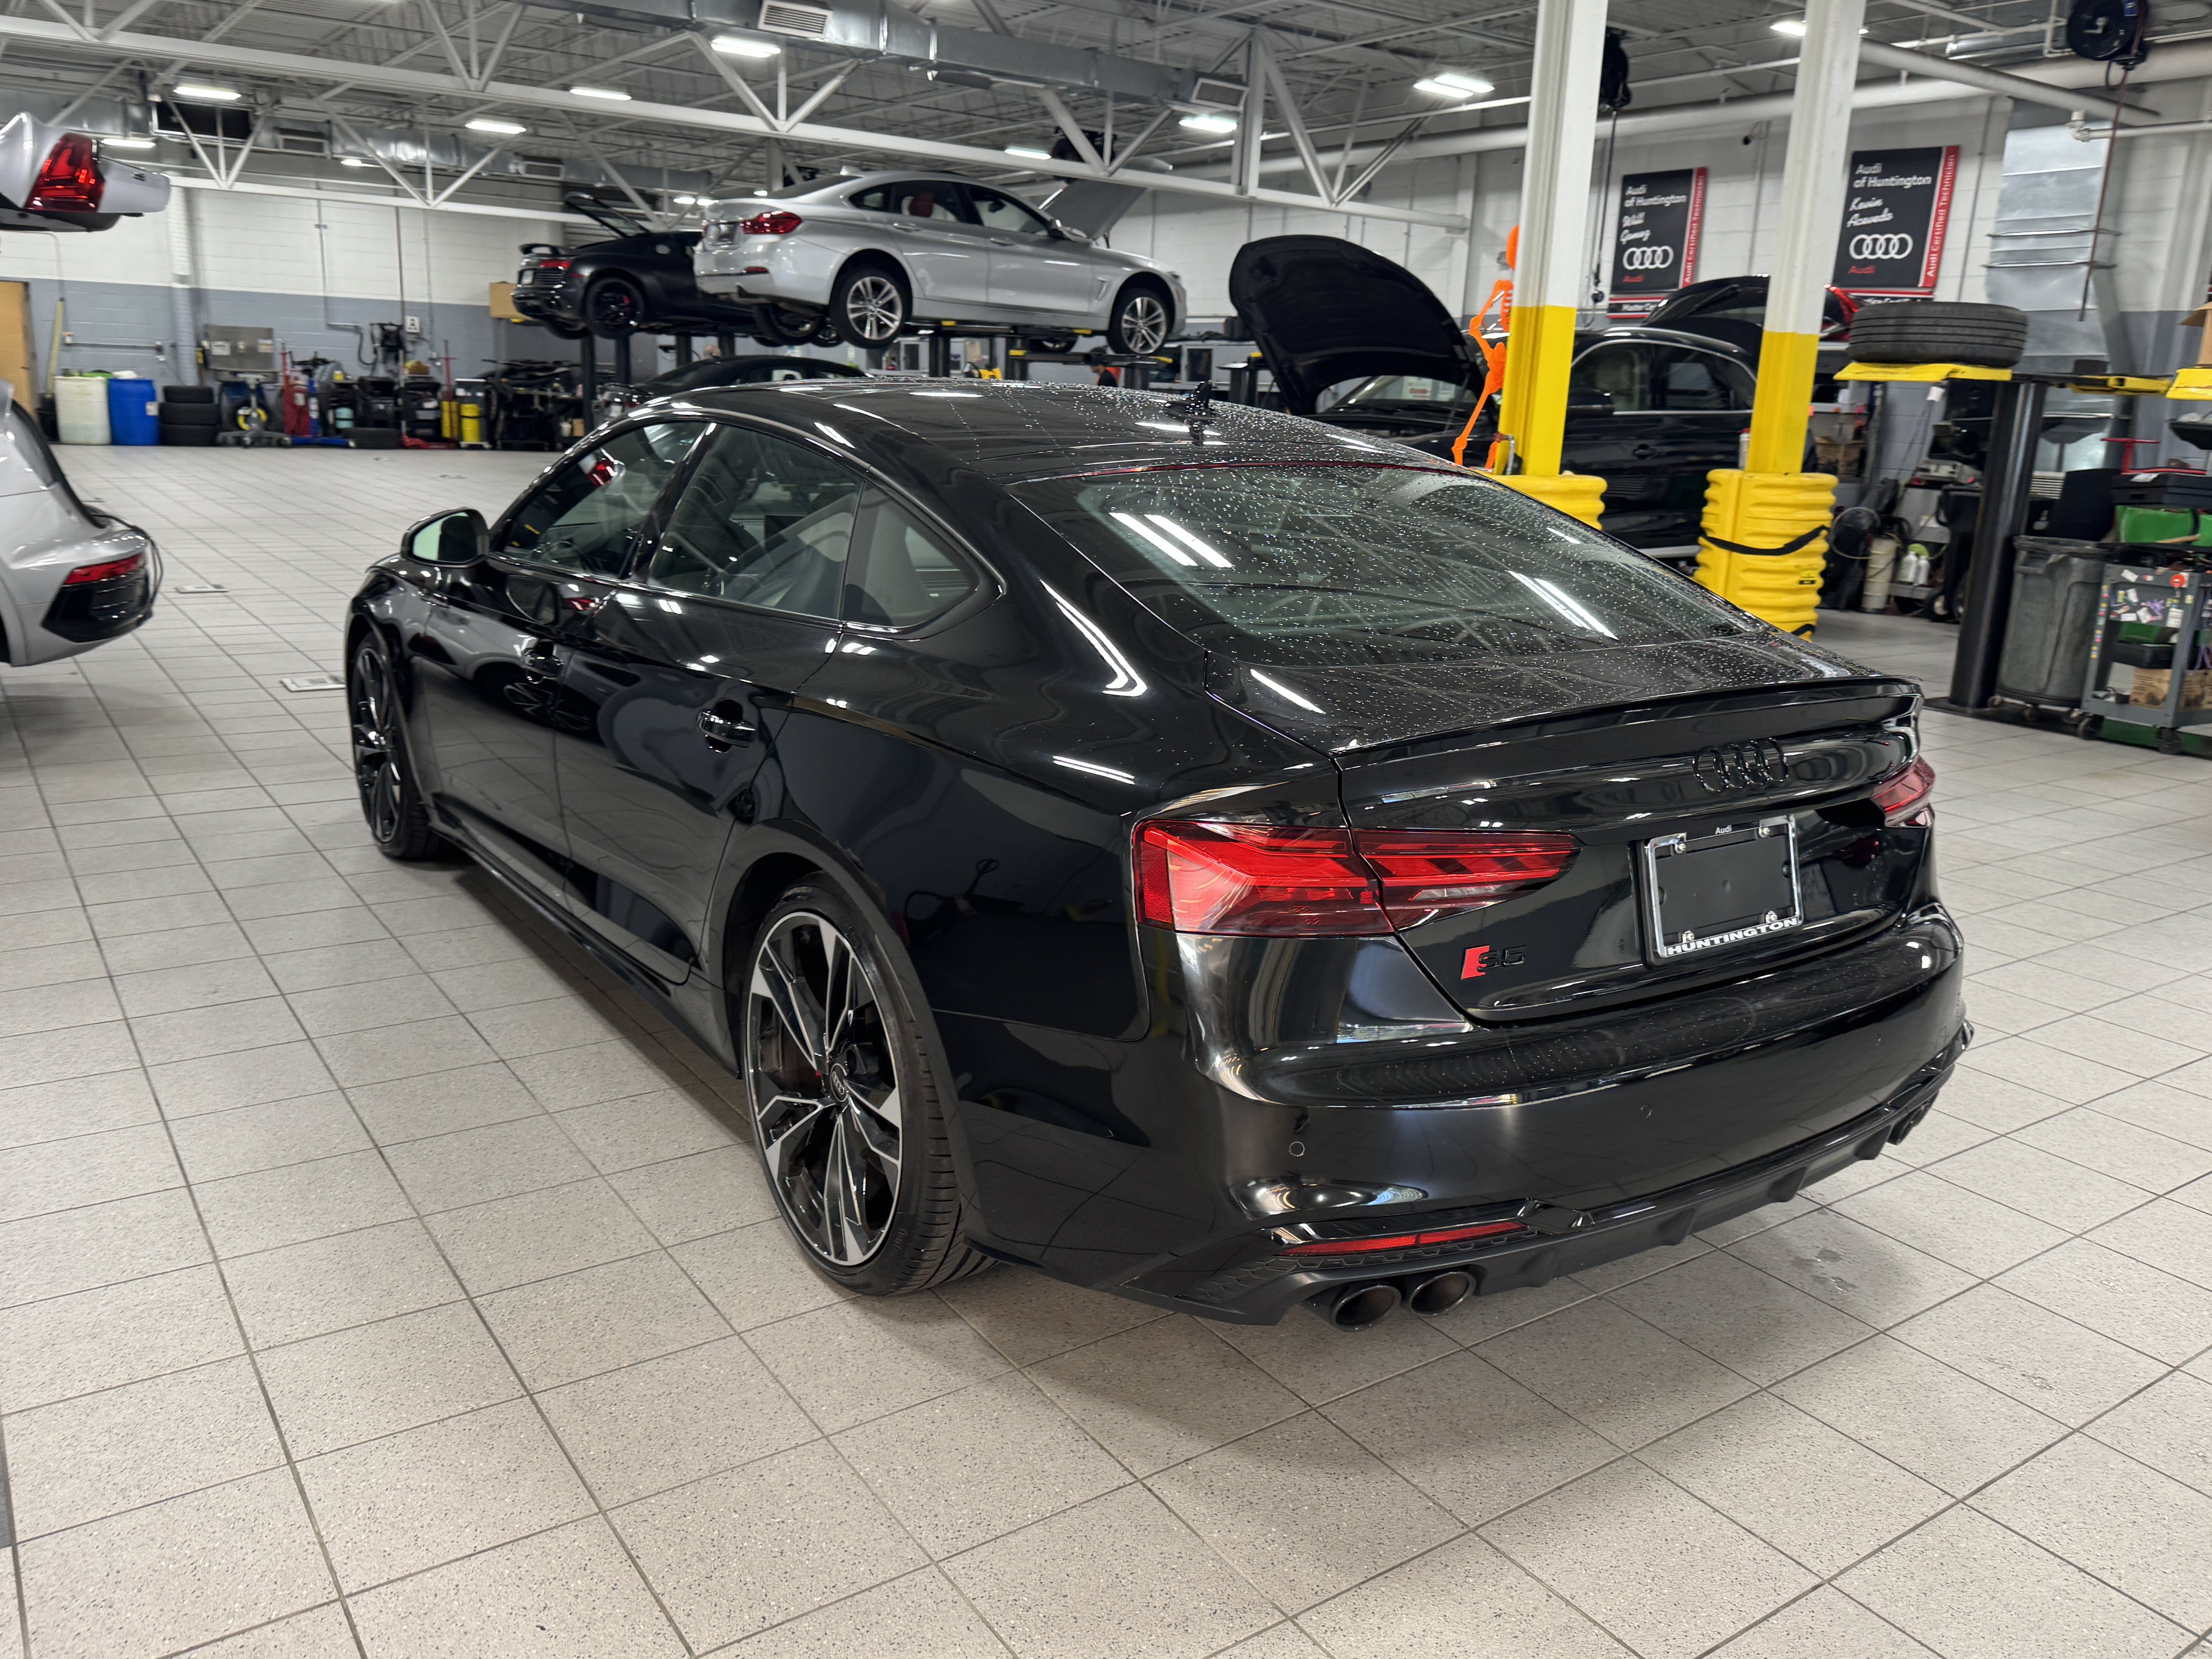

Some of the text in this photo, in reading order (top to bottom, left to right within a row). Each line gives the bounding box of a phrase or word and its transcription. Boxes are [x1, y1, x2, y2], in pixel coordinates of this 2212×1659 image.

[1855, 163, 1883, 174] Audi
[1853, 175, 1933, 189] of Huntington
[1625, 184, 1647, 196] Audi
[1624, 194, 1687, 208] of Huntington
[1848, 197, 1884, 211] Kevin
[1927, 155, 1954, 277] Audi Certified Technician
[1684, 175, 1704, 283] Audi Certified Technician
[1848, 265, 1876, 274] Audi
[1623, 274, 1644, 283] Audi
[1715, 824, 1732, 835] Audi
[1666, 917, 1798, 955] HUNTINGTON
[1471, 944, 1529, 974] S5
